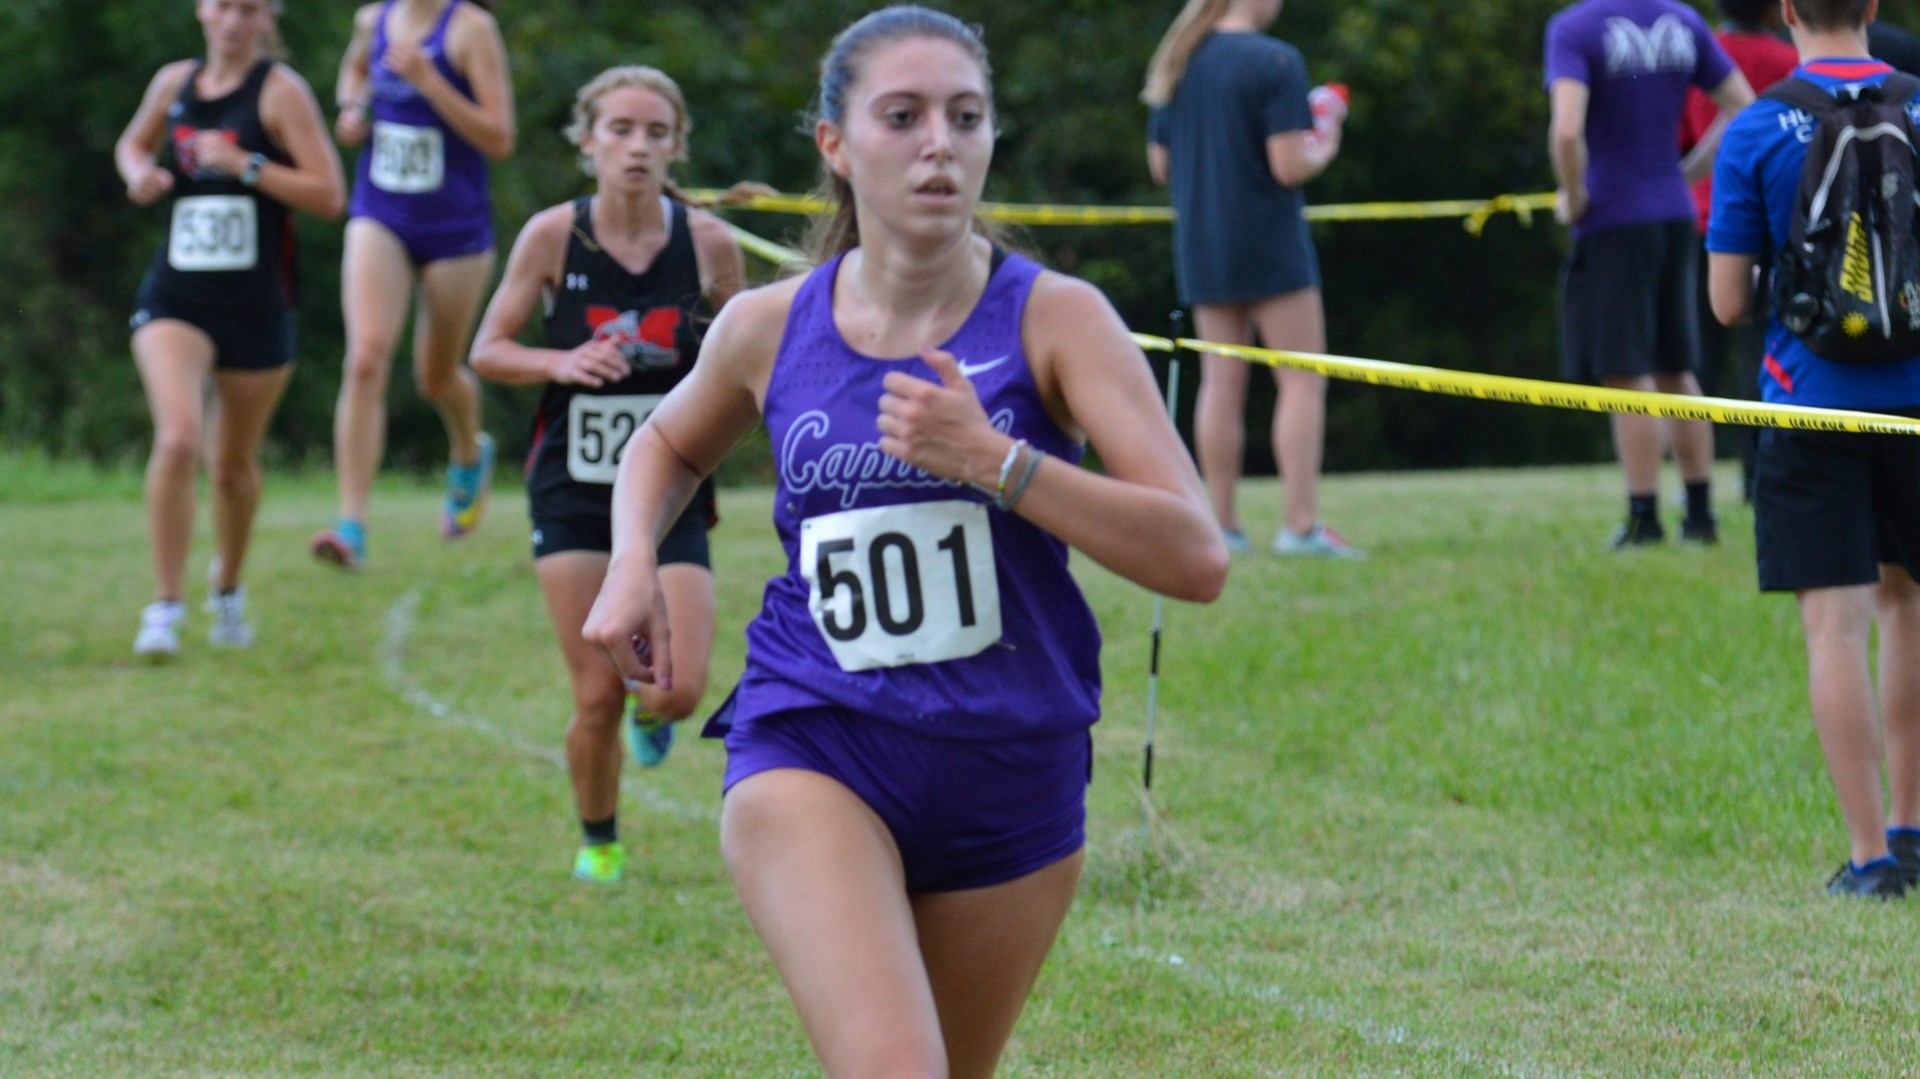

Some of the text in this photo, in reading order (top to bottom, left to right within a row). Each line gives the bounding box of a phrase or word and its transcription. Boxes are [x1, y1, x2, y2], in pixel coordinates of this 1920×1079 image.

[180, 208, 247, 256] 530
[581, 409, 656, 466] 52
[816, 524, 977, 642] 501
